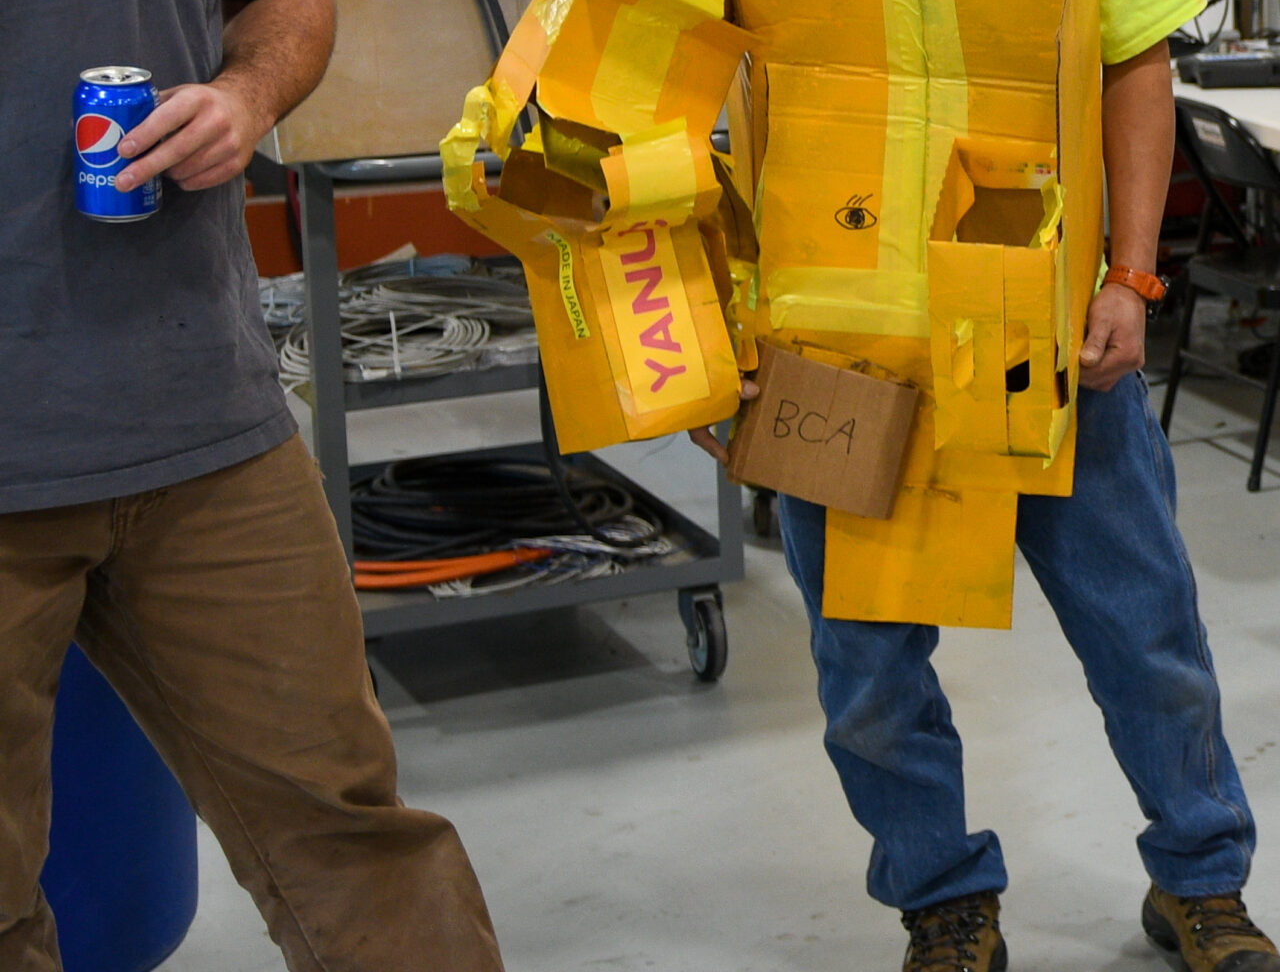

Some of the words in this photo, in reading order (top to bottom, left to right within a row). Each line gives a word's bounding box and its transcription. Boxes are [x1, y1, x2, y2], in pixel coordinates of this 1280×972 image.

[79, 171, 116, 188] peps
[562, 275, 572, 291] IN
[565, 294, 587, 339] JAPAN
[617, 218, 687, 394] YANU
[773, 399, 856, 455] BCA
